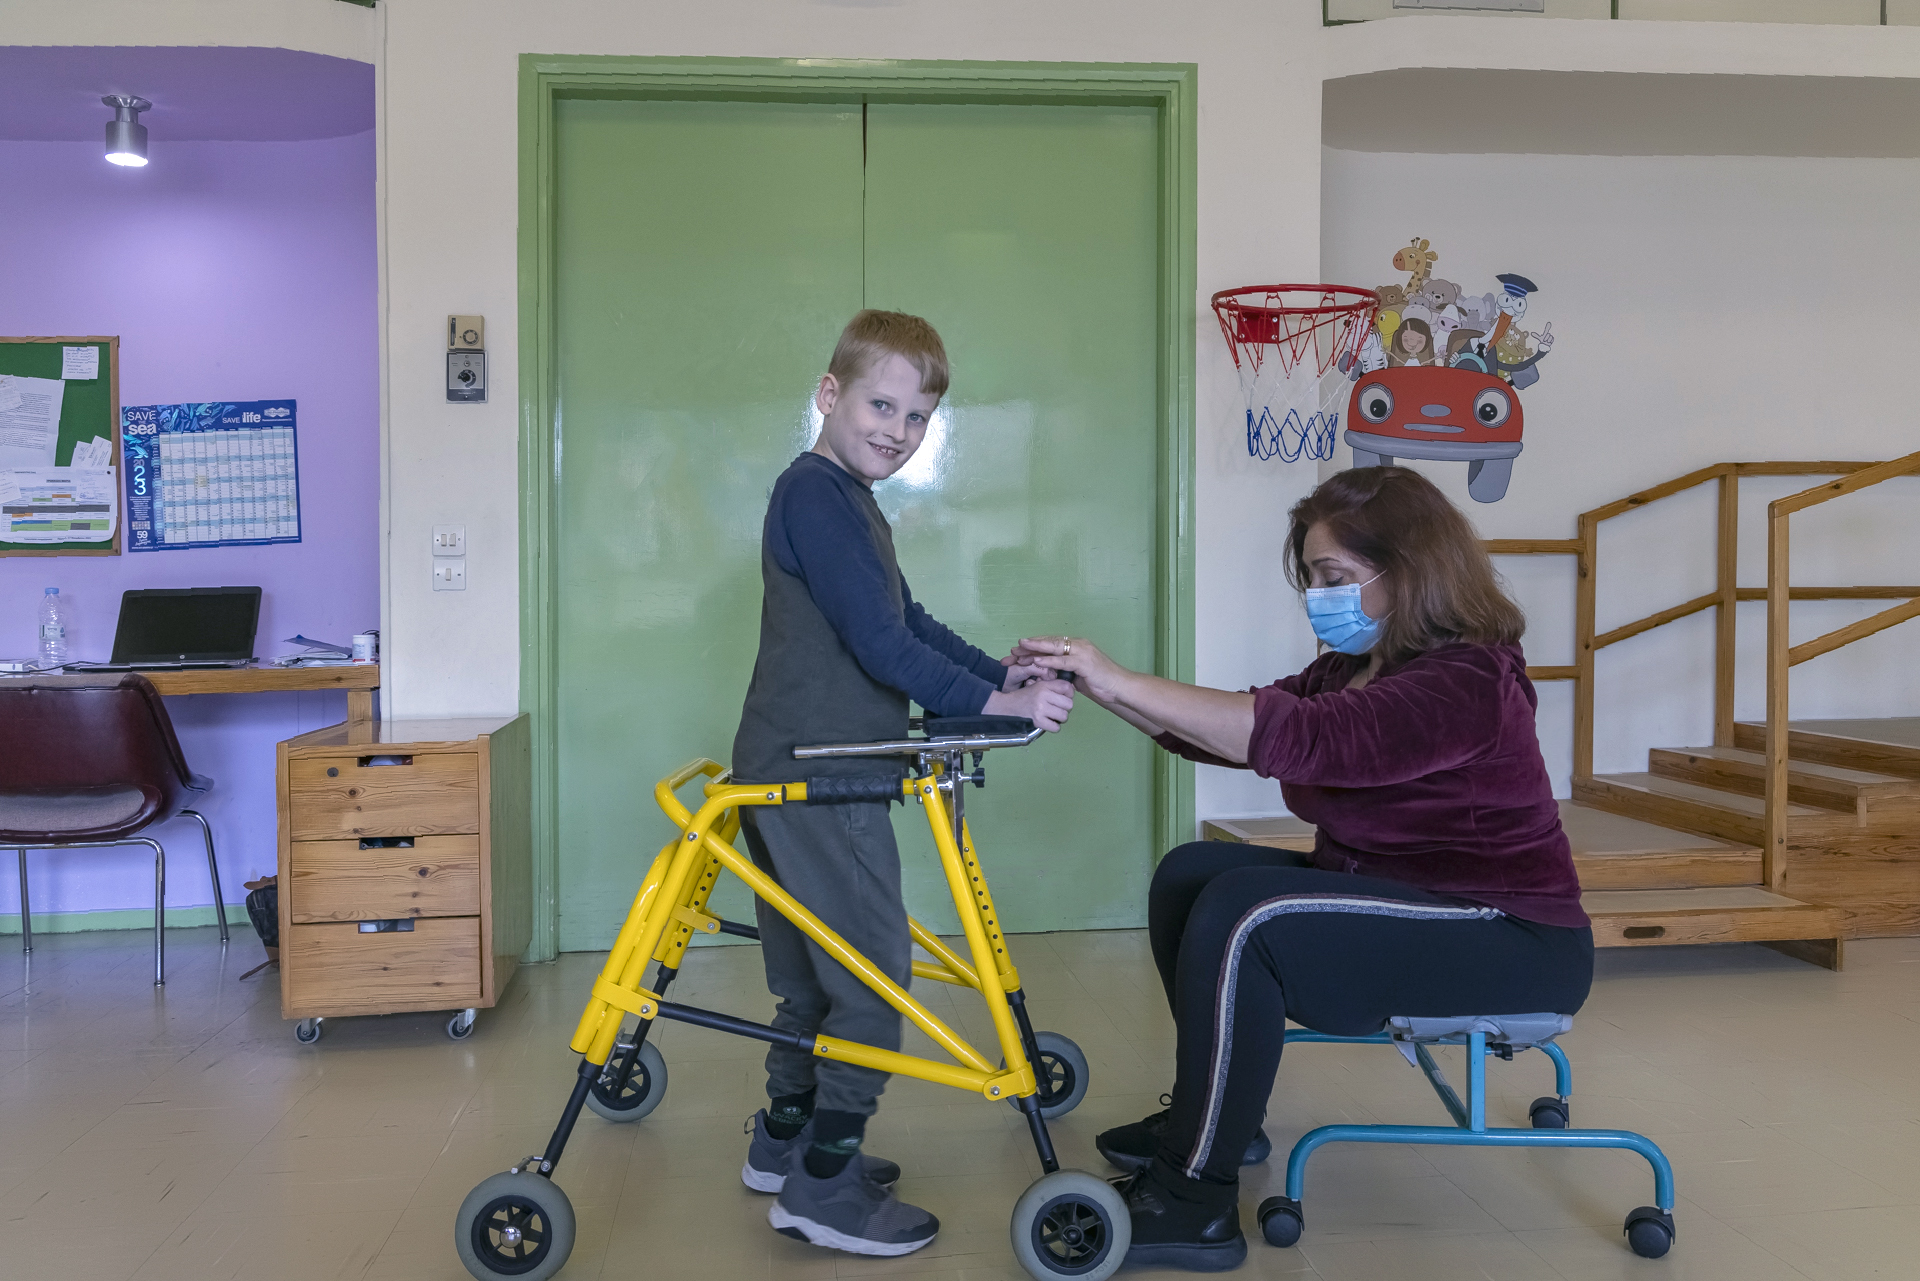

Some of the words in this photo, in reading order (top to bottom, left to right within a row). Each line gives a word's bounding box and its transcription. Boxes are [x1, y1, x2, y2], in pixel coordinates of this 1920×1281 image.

[127, 410, 157, 421] SAVE
[242, 411, 261, 423] life
[128, 423, 157, 435] sea
[136, 530, 148, 539] 59
